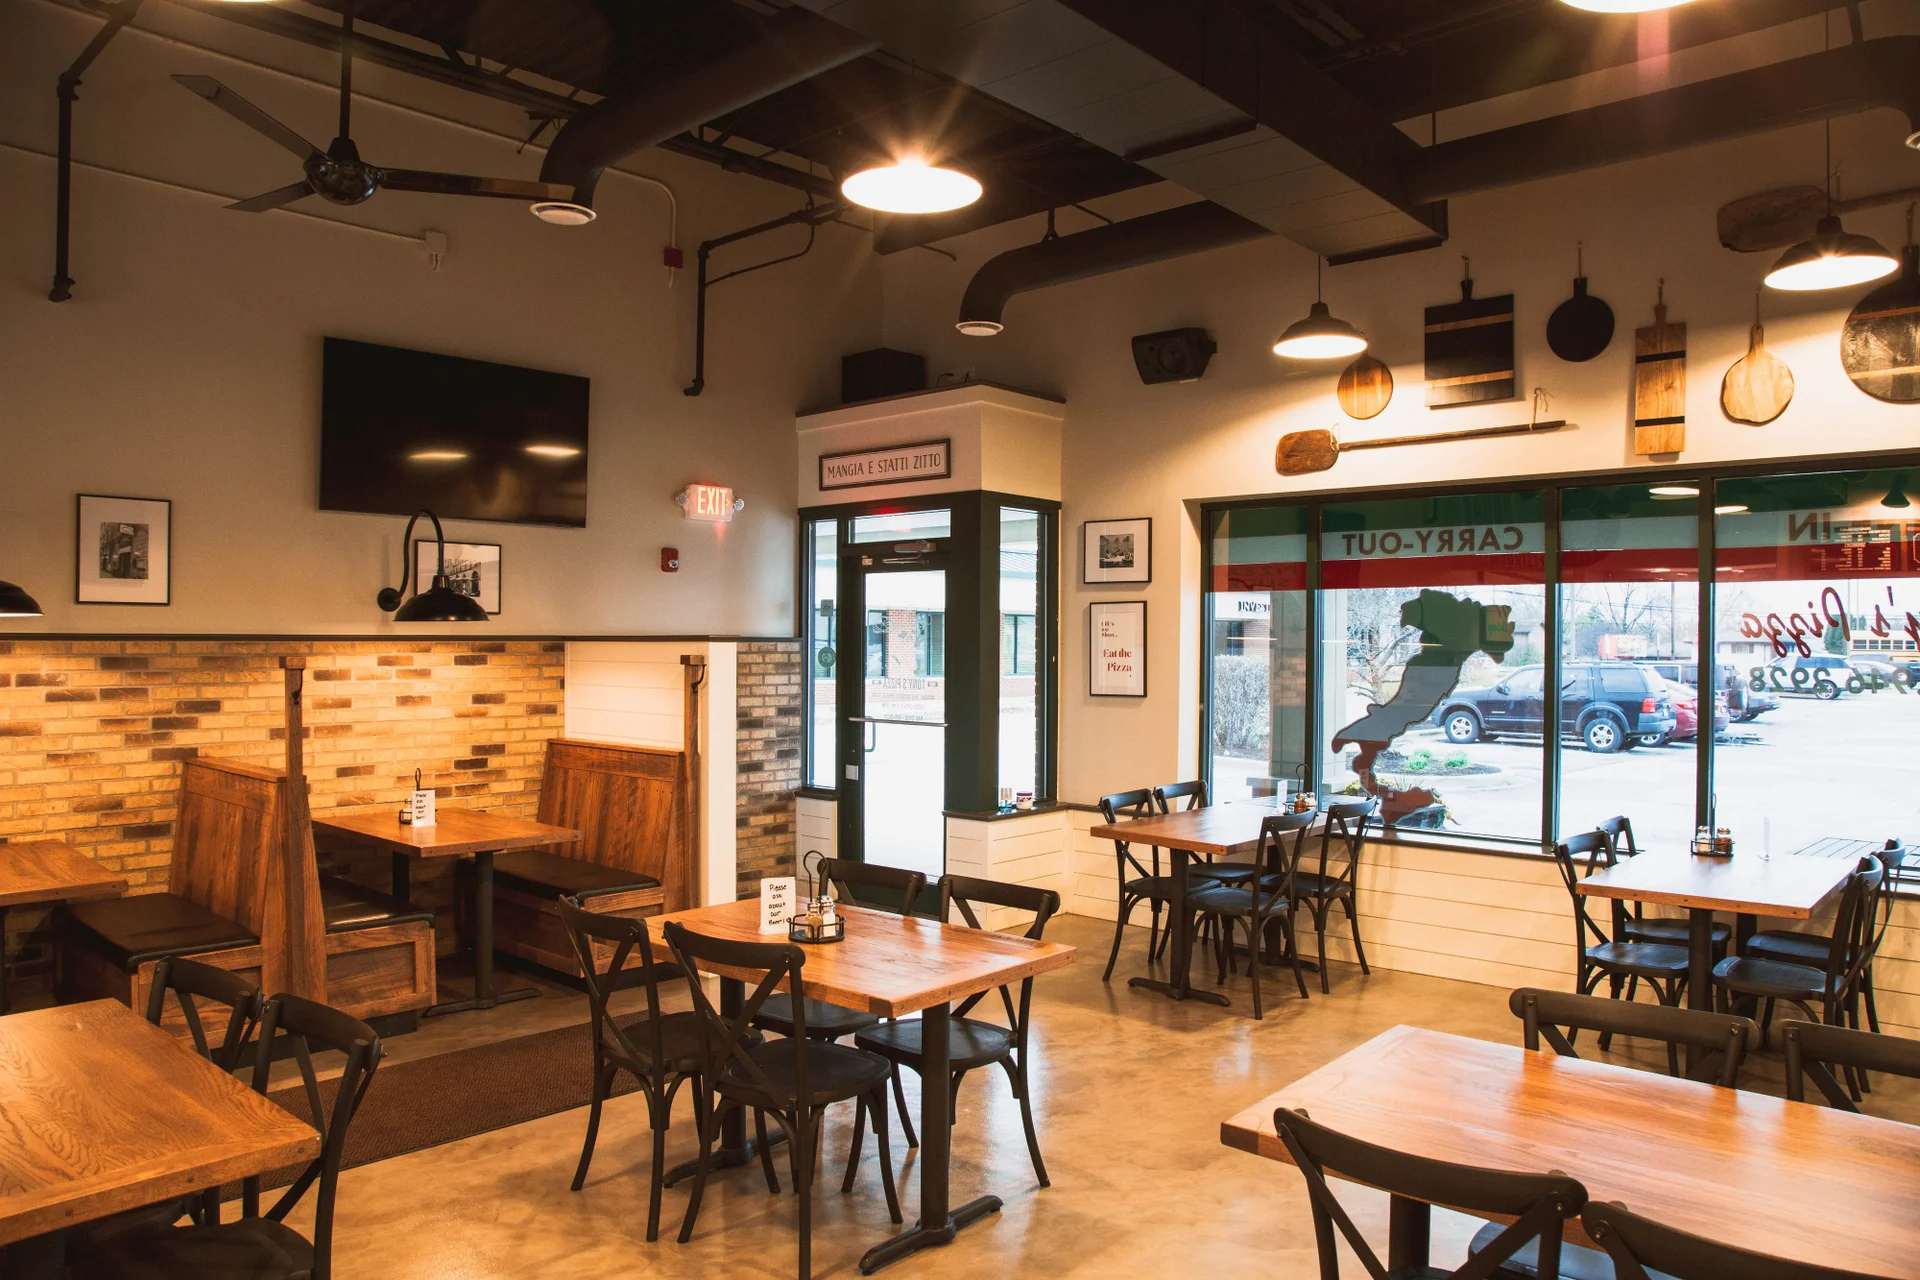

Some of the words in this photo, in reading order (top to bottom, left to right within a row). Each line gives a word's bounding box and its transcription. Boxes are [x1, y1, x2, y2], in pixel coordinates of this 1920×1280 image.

[827, 463, 864, 479] MANGIA
[868, 461, 874, 474] E
[878, 457, 908, 473] STATTI
[913, 453, 941, 470] ZITTO
[697, 486, 728, 517] EXIT
[1103, 648, 1117, 658] Eat
[1118, 648, 1132, 658] the
[1107, 662, 1132, 672] Pizza
